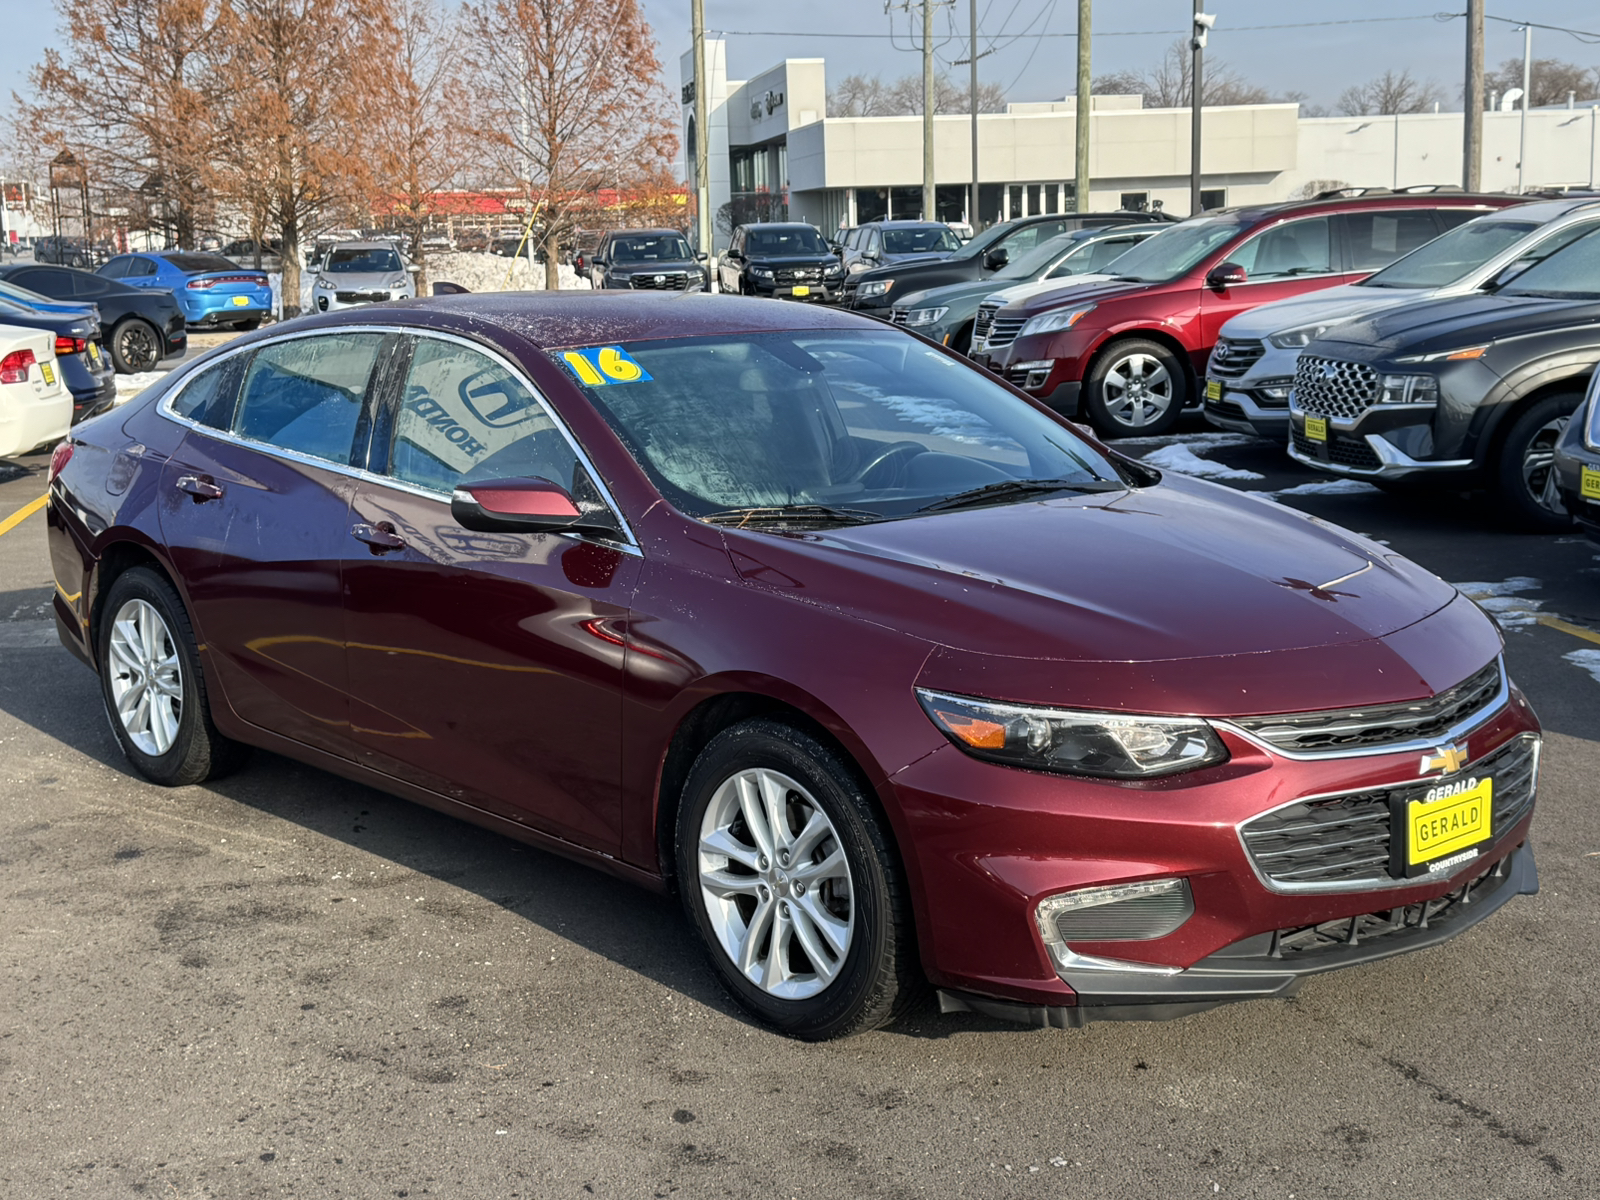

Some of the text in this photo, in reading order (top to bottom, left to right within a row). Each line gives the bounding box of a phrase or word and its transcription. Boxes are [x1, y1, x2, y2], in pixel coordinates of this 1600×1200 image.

[564, 348, 641, 385] 16
[1427, 777, 1477, 802] GERALD
[1420, 807, 1478, 841] GERALD
[1429, 848, 1478, 872] COUNTRYSIDE
